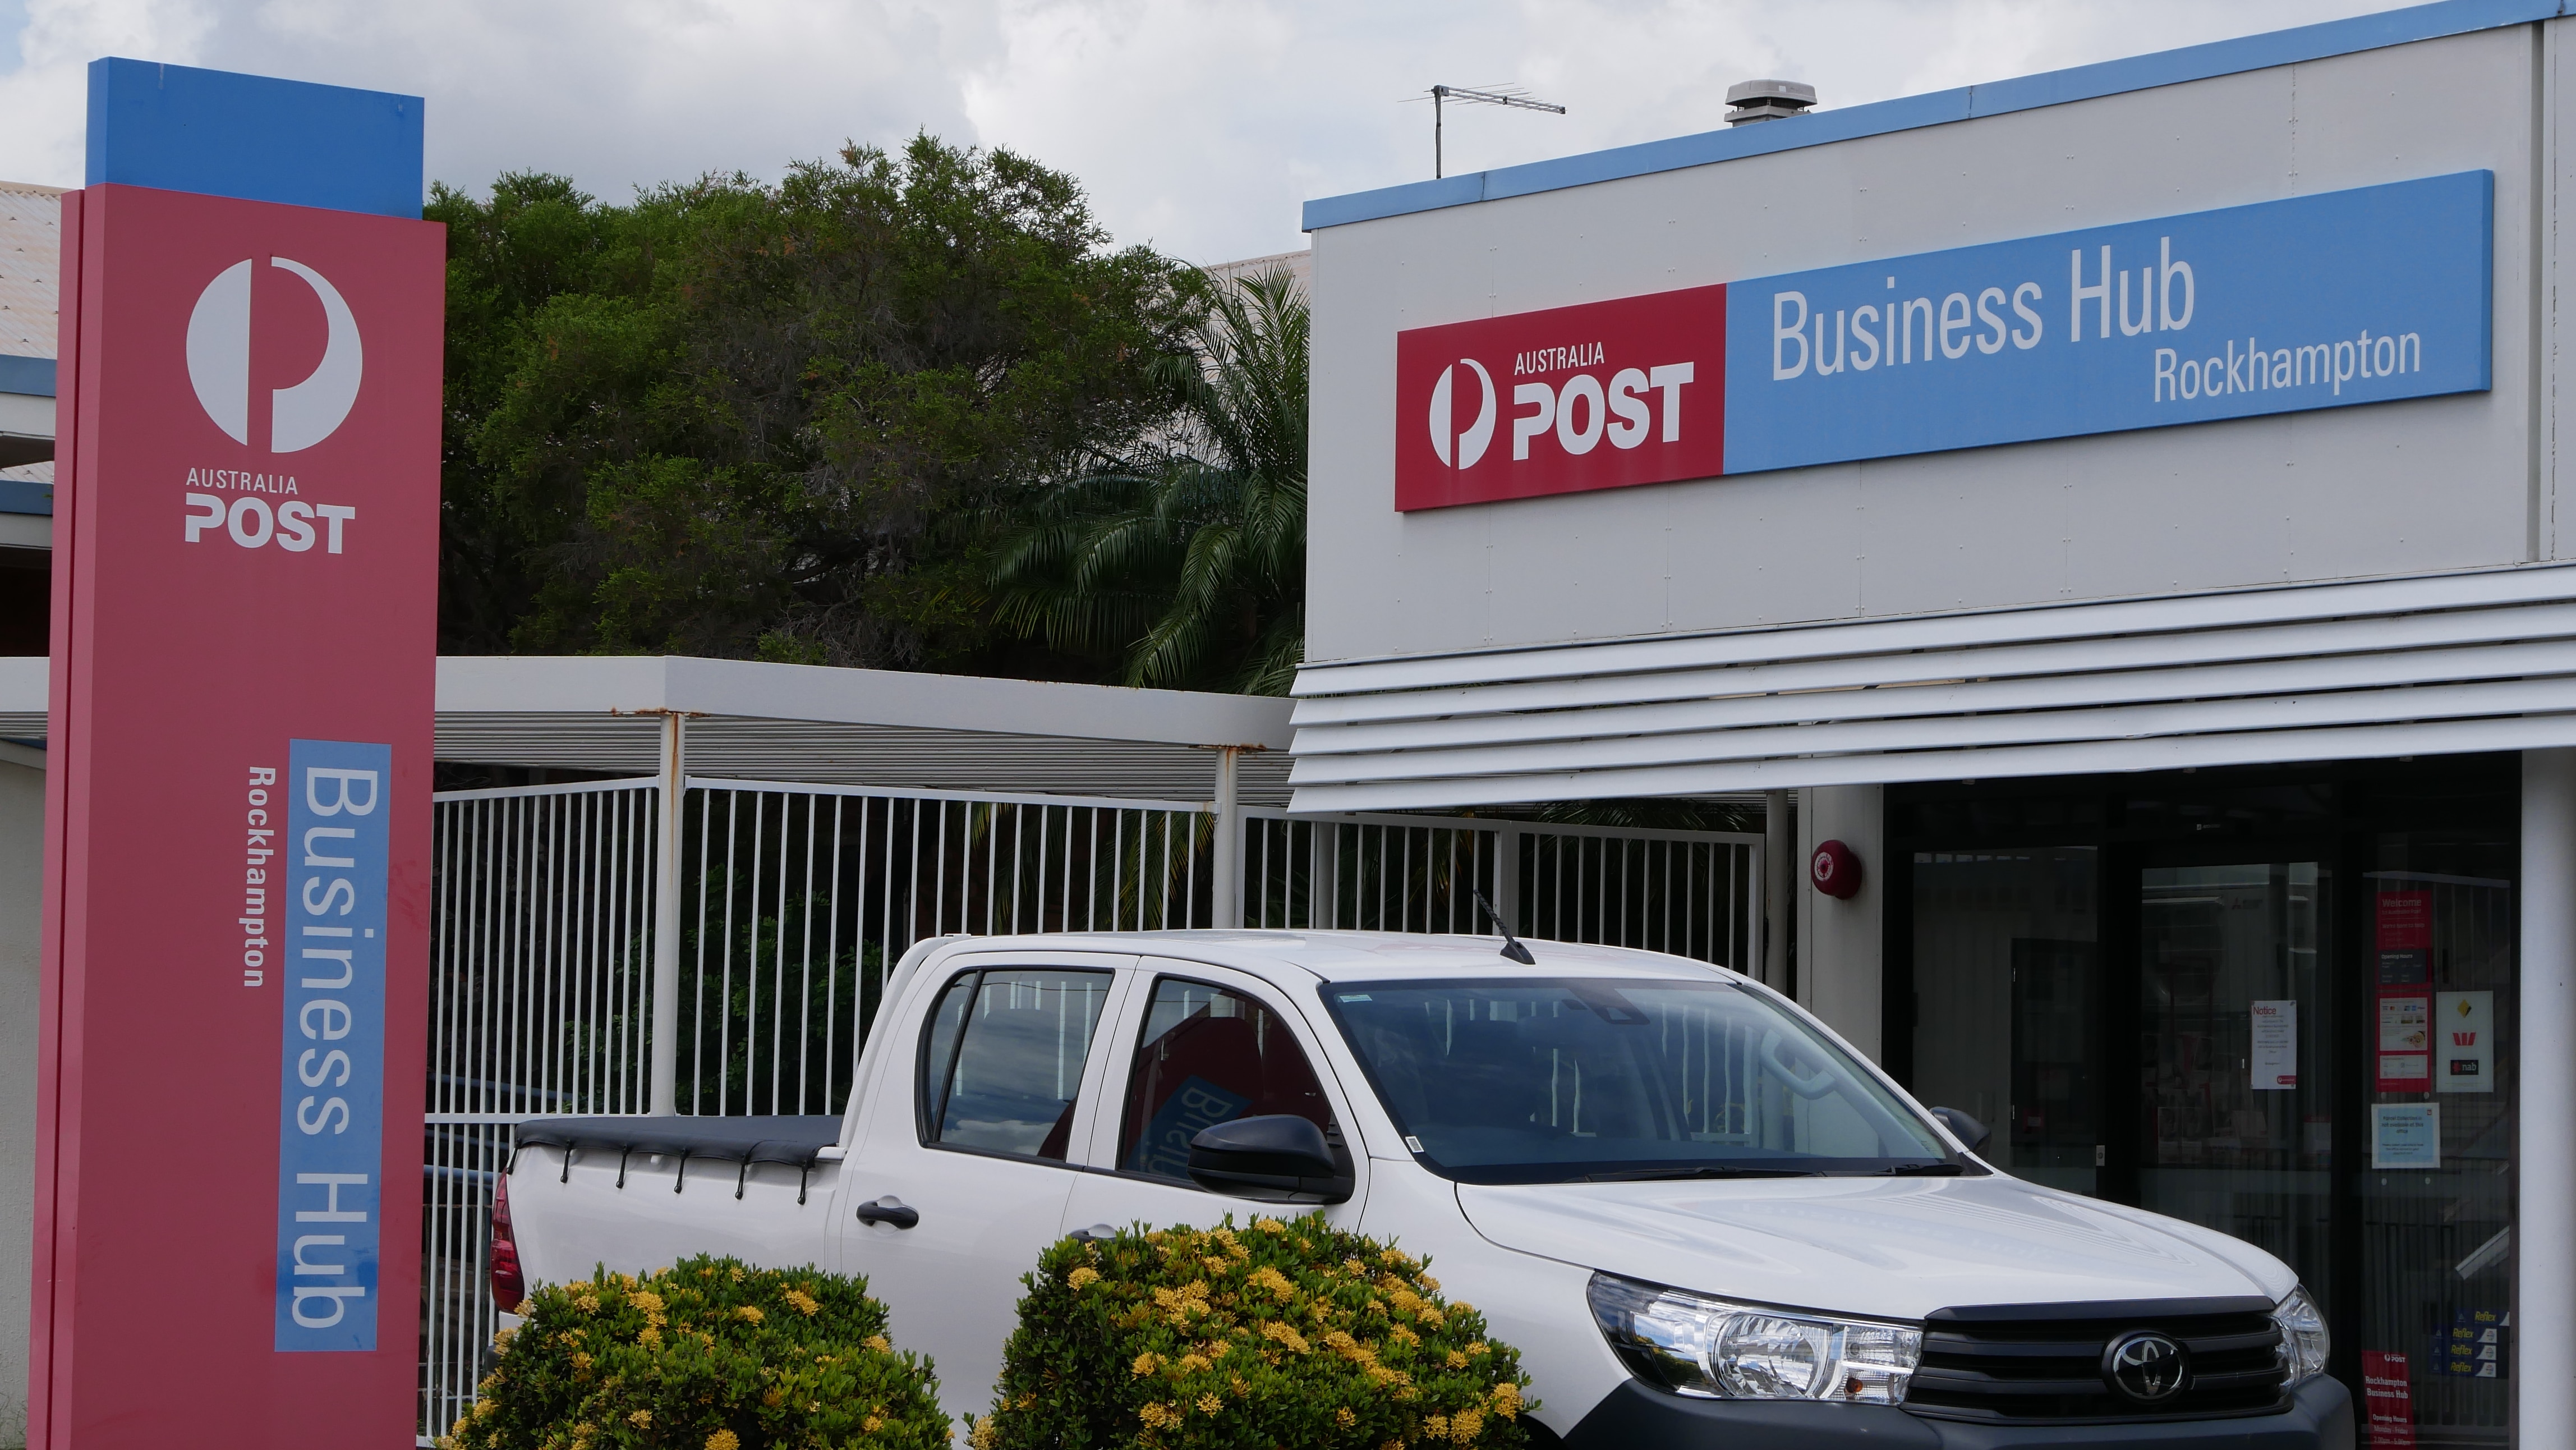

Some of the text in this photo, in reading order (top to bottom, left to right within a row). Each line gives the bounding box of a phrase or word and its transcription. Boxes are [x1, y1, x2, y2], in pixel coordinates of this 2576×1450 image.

[1773, 236, 2196, 381] Business Hub
[1514, 341, 1605, 375] AUSTRALIA
[2154, 329, 2421, 403] Rockhampton
[1513, 361, 1694, 461] POST
[186, 467, 298, 495] AUSTRALIA
[185, 492, 356, 554] POST
[238, 766, 276, 988] Rockhampton
[2382, 898, 2422, 907] Welcome
[2253, 1006, 2276, 1015] Notice
[292, 767, 379, 1329] Business Hub
[2462, 1062, 2477, 1071] nab
[2474, 1311, 2496, 1321] Reflex
[2452, 1328, 2474, 1338] Reflex
[2451, 1345, 2472, 1356] Reflex
[2450, 1361, 2472, 1373] Reflex
[2365, 1375, 2408, 1388] Rockhampton
[2366, 1388, 2408, 1399] Business Hub
[2372, 1414, 2407, 1424] Opening Hours
